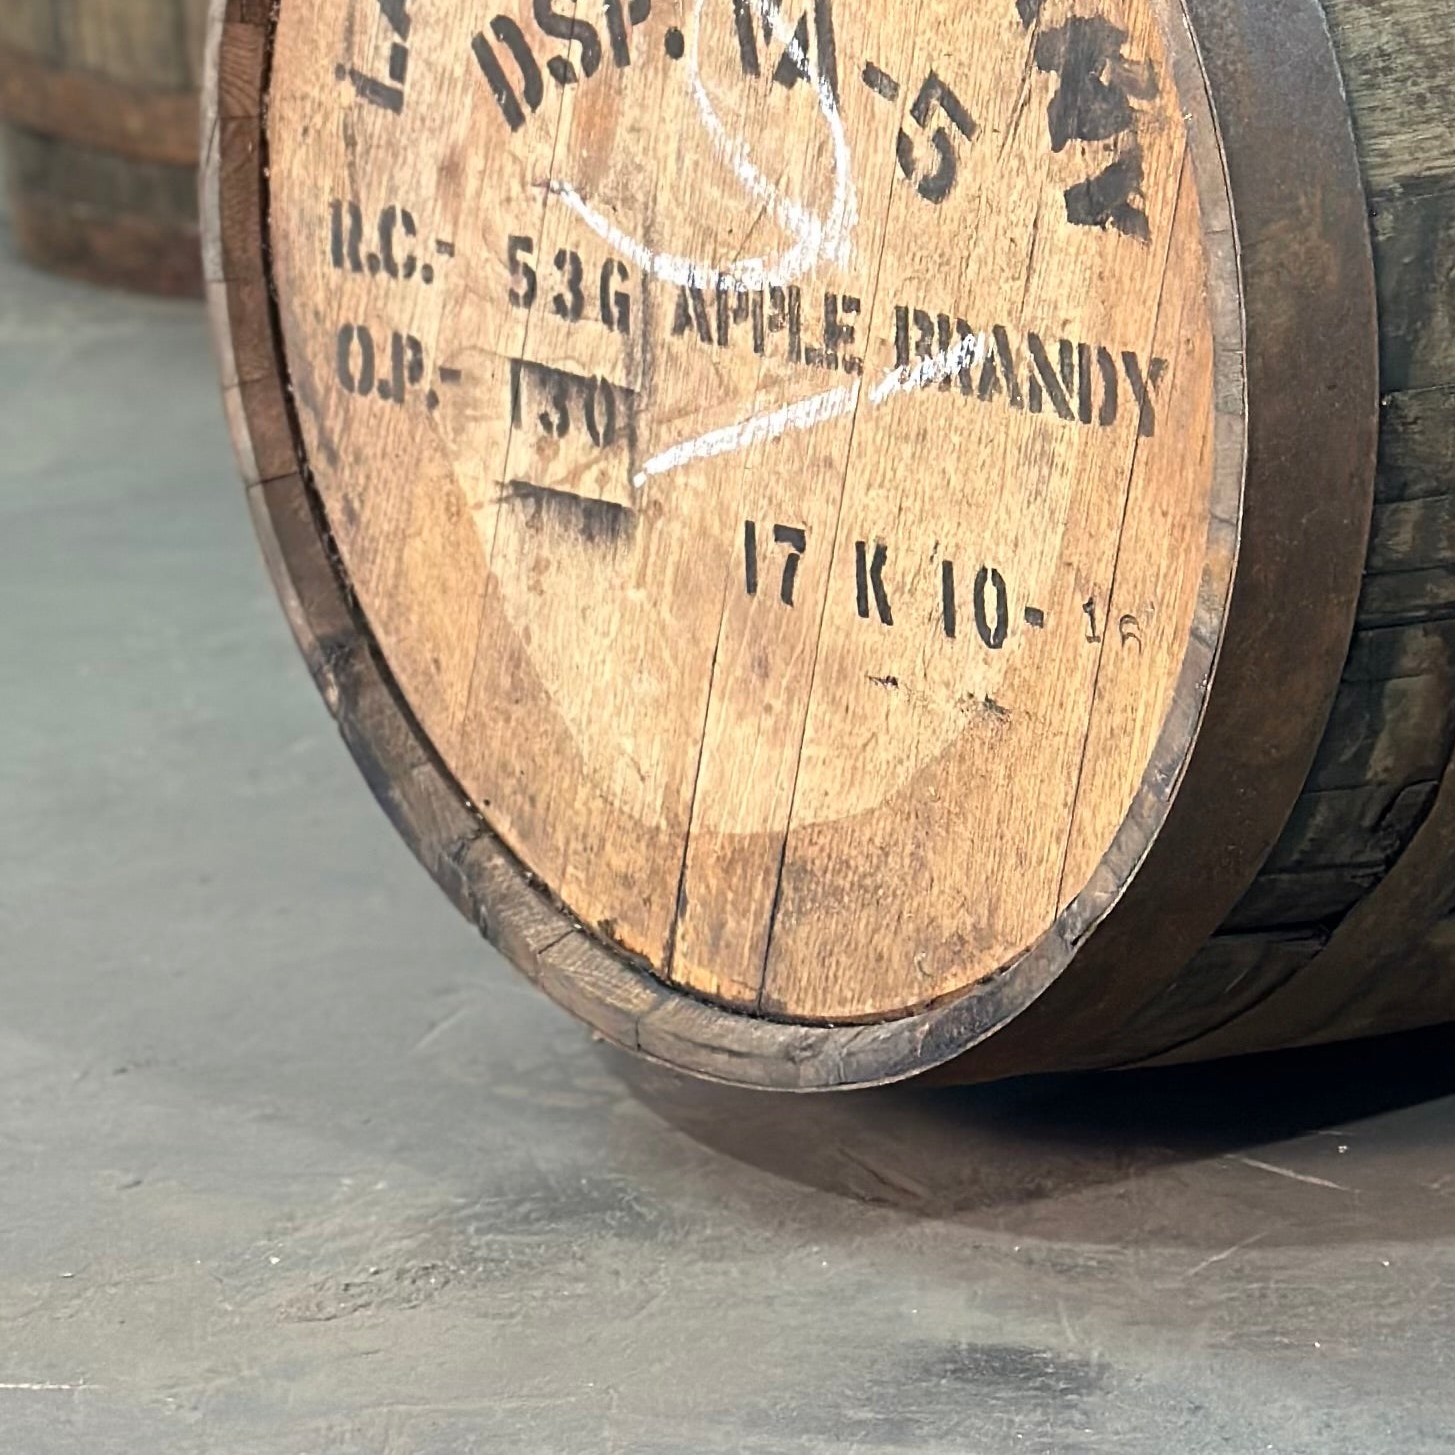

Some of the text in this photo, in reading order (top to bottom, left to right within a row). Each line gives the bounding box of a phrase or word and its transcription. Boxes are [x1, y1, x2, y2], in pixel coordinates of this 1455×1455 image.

[671, 267, 862, 377] APPLE
[895, 305, 1170, 437] BRANDY
[744, 519, 806, 606] 17
[855, 540, 894, 626] K
